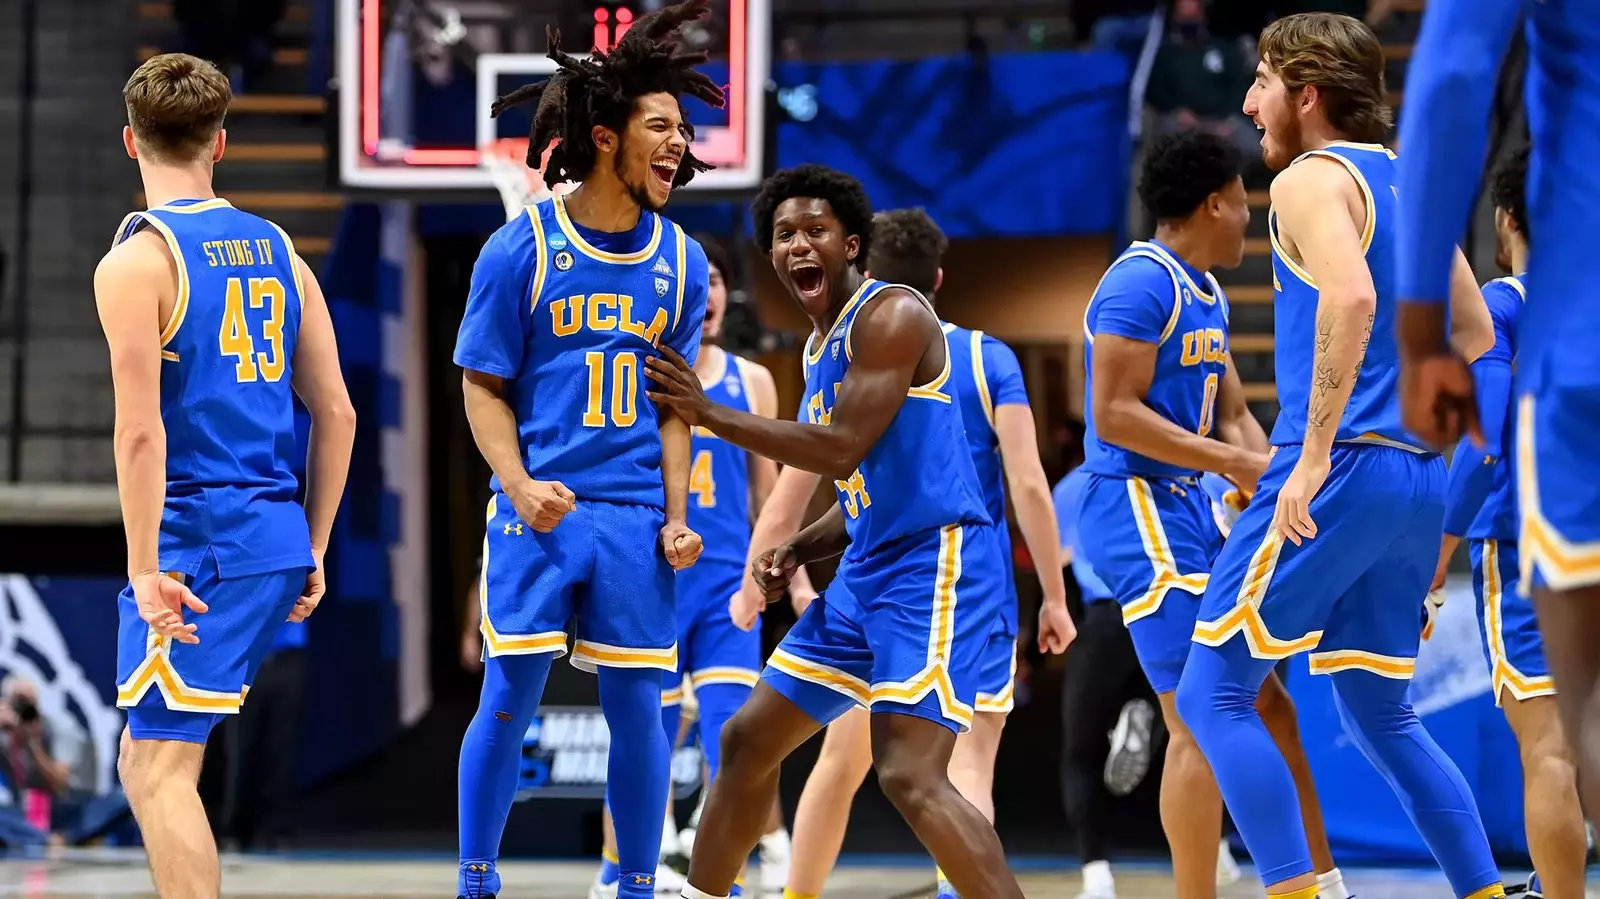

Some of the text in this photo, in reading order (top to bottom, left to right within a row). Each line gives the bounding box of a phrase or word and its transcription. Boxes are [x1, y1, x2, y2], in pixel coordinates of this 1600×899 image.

[202, 238, 273, 267] STONG IV
[219, 277, 286, 383] 43
[549, 293, 668, 349] UCLA
[583, 351, 637, 428] 10
[1197, 373, 1219, 437] 0
[689, 449, 717, 508] 4
